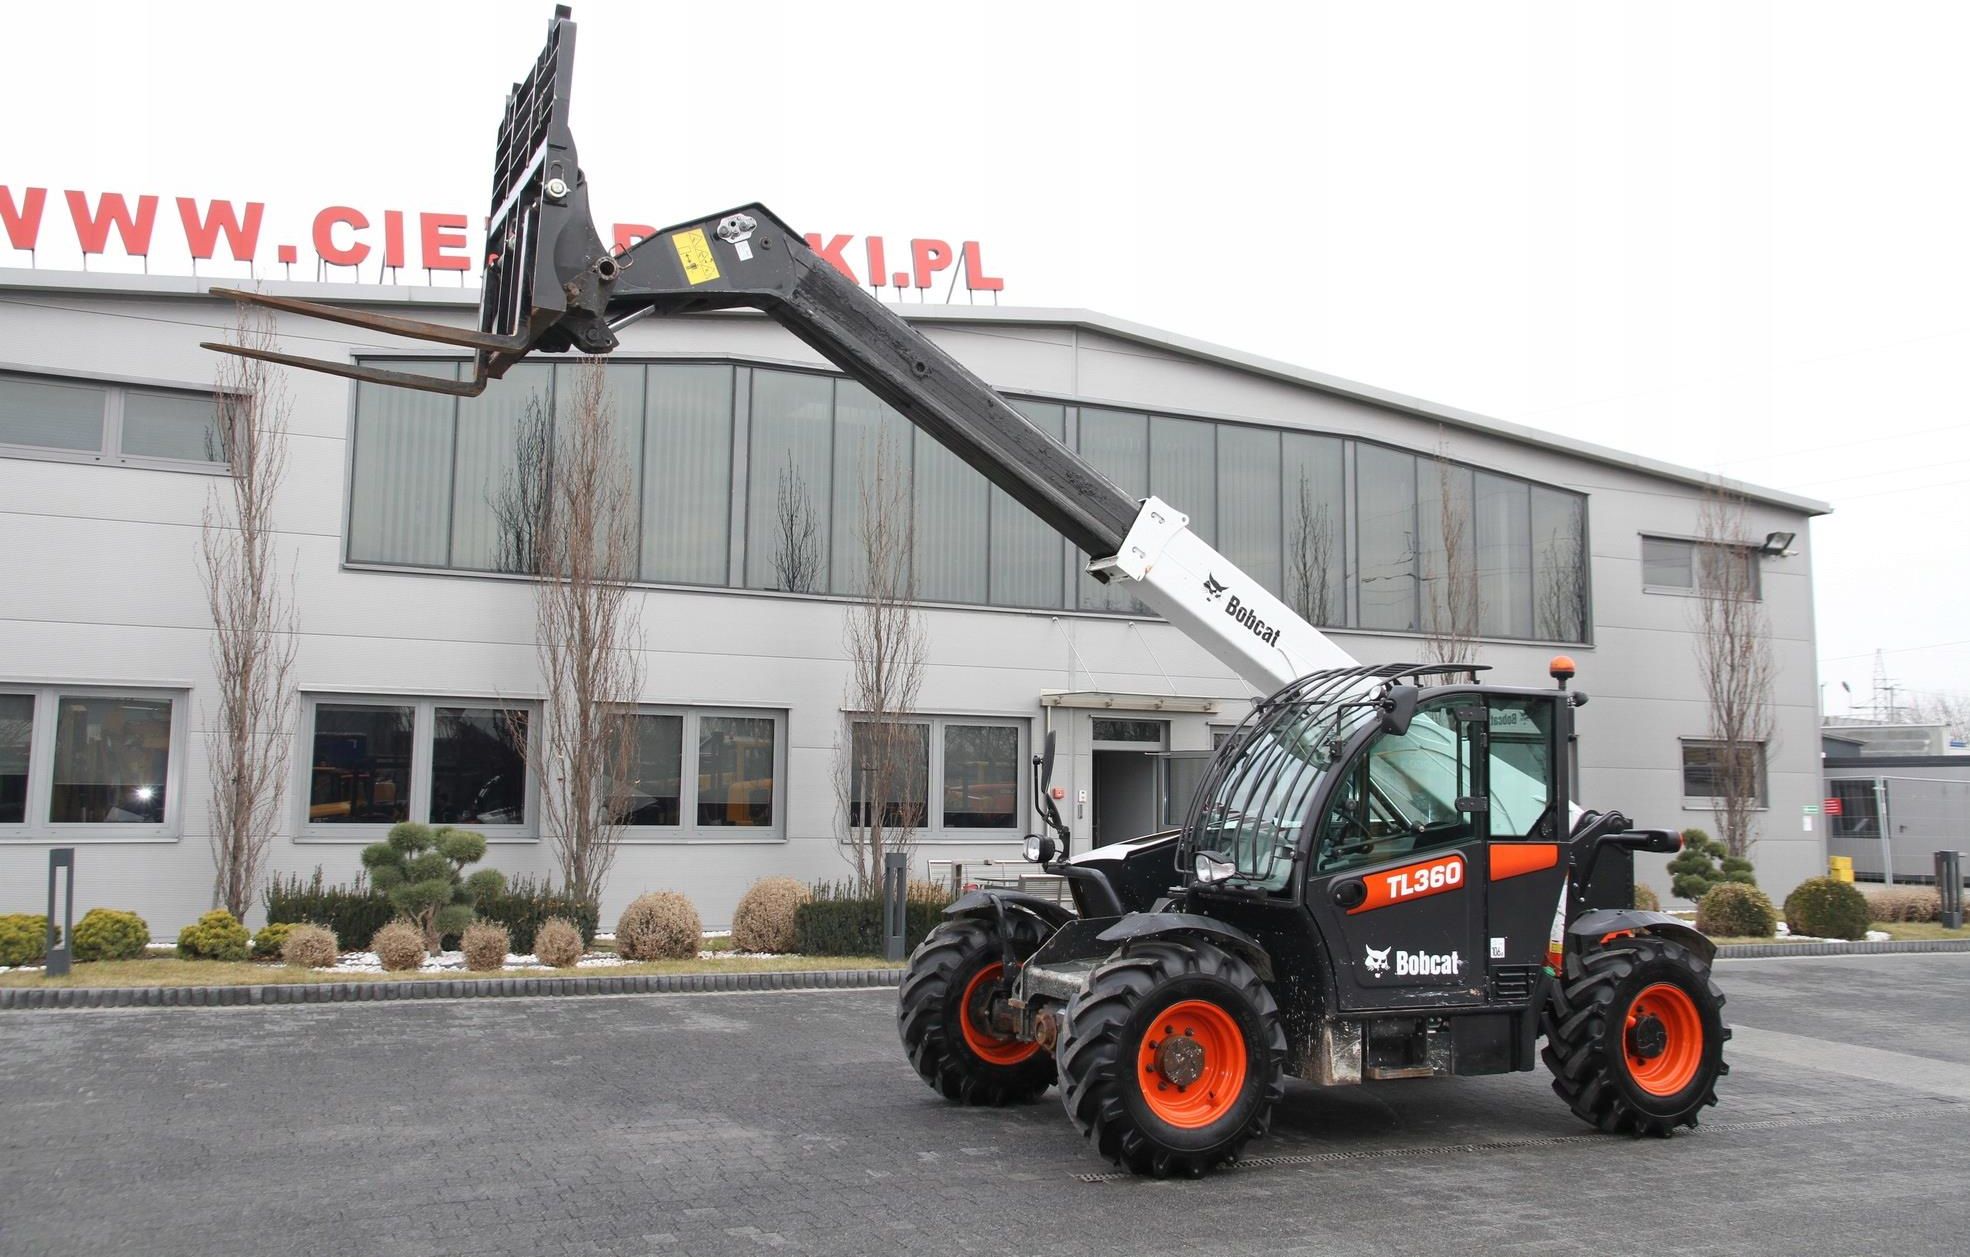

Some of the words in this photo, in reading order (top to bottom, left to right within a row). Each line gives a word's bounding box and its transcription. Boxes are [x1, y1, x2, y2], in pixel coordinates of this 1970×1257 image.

[1224, 595, 1281, 647] Bobcat
[1386, 861, 1461, 899] TL360
[1396, 950, 1459, 975] Bobcat
